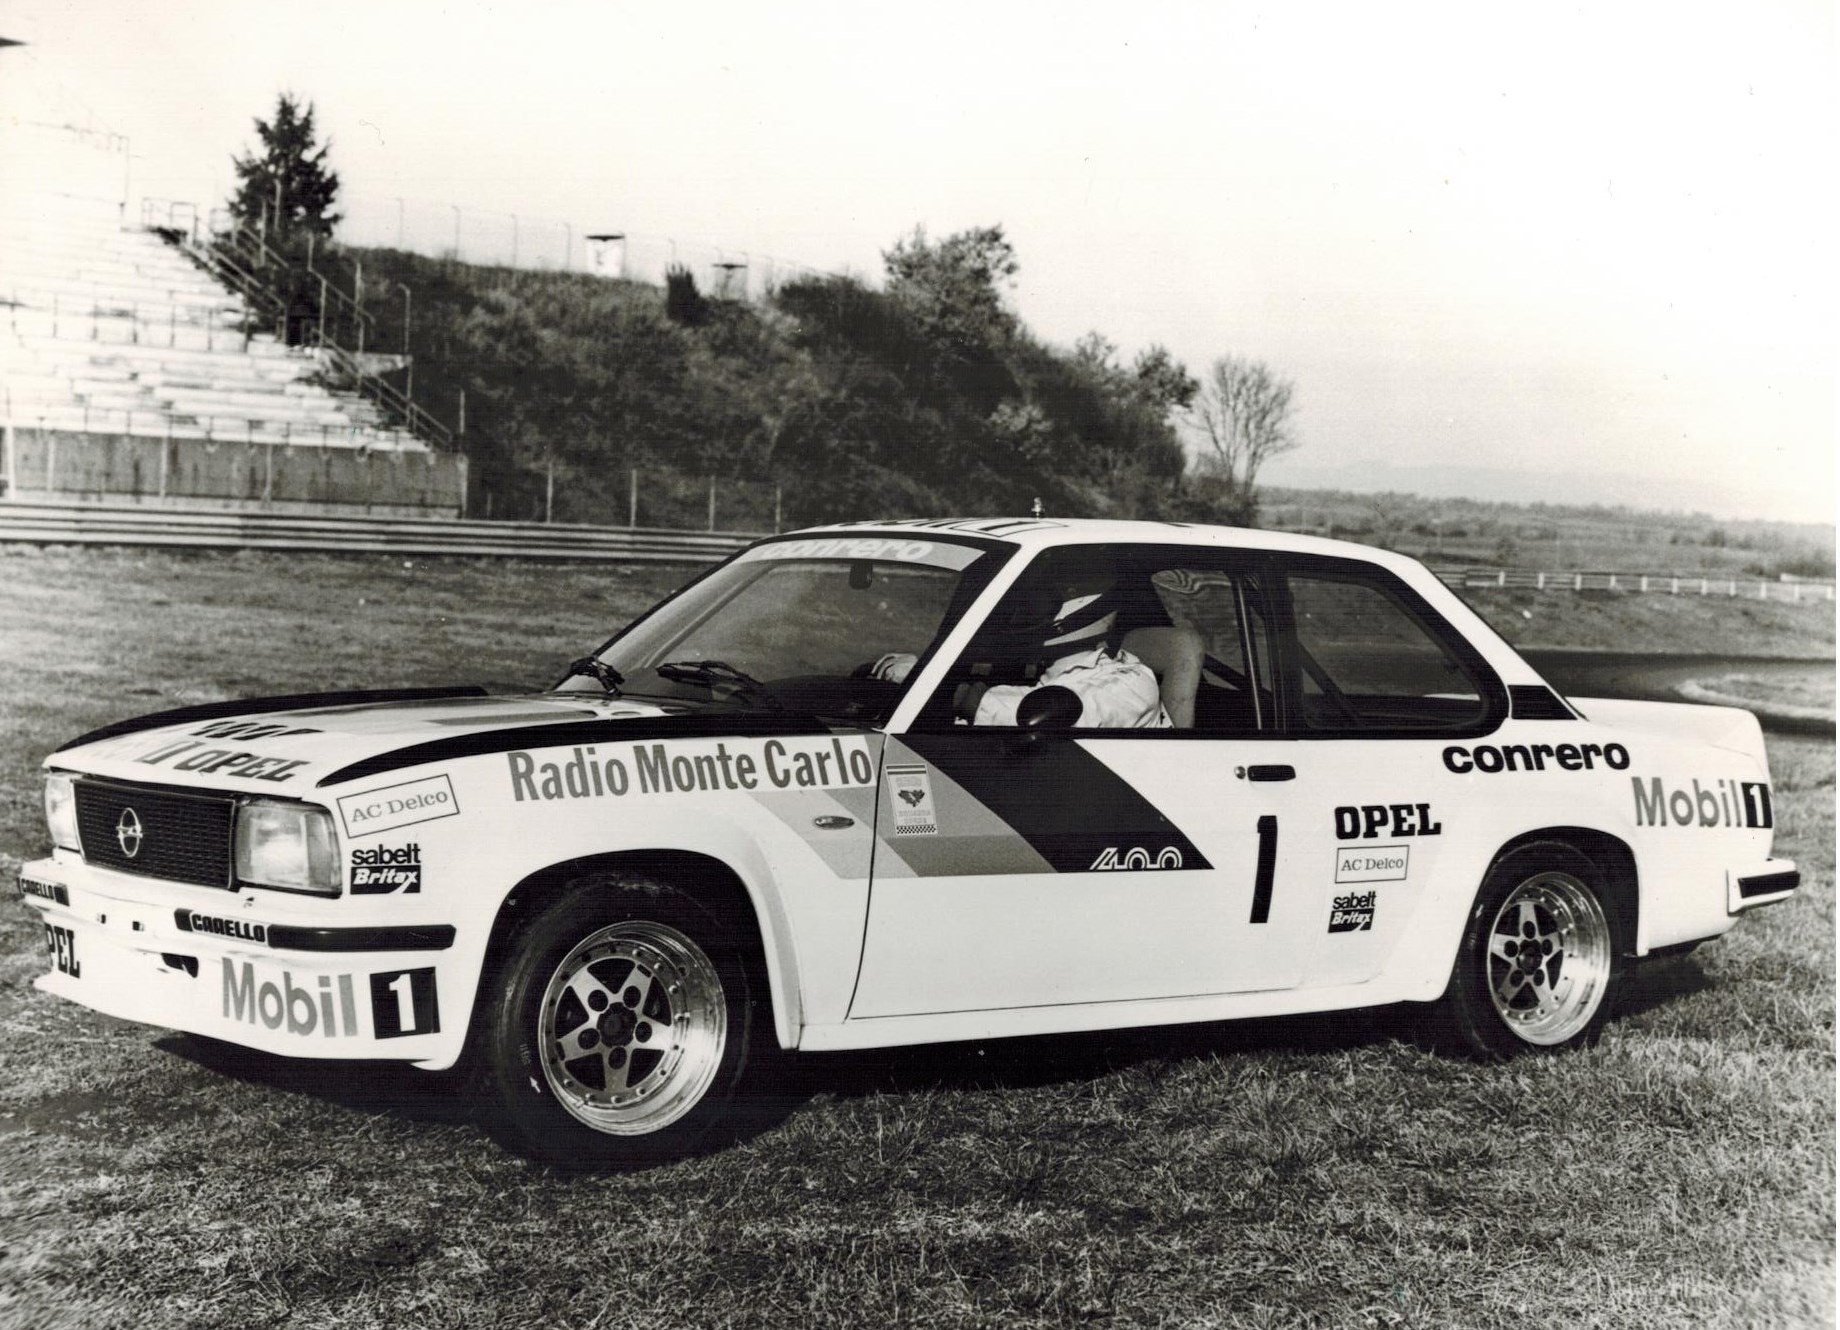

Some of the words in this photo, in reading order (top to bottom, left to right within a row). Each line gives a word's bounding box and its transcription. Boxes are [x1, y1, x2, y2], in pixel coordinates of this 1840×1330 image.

[173, 749, 312, 782] OPEL
[507, 747, 628, 801] Radio
[633, 743, 759, 793] Monte
[764, 738, 872, 788] Carlo
[1442, 742, 1631, 774] conrero
[352, 804, 382, 822] AC
[386, 791, 448, 814] Delco
[1631, 776, 1742, 827] Mobil
[1334, 803, 1442, 840] OPEL
[351, 843, 421, 865] sabelt
[1089, 846, 1183, 870] 400
[1249, 815, 1278, 923] 1
[1341, 859, 1362, 871] AC
[1365, 857, 1404, 870] Delco
[353, 868, 418, 887] Britax
[1332, 891, 1377, 910] sabelt
[192, 914, 266, 942] CARELLO
[1331, 911, 1372, 927] Britax
[45, 922, 80, 979] PEL
[222, 957, 358, 1038] Mobil
